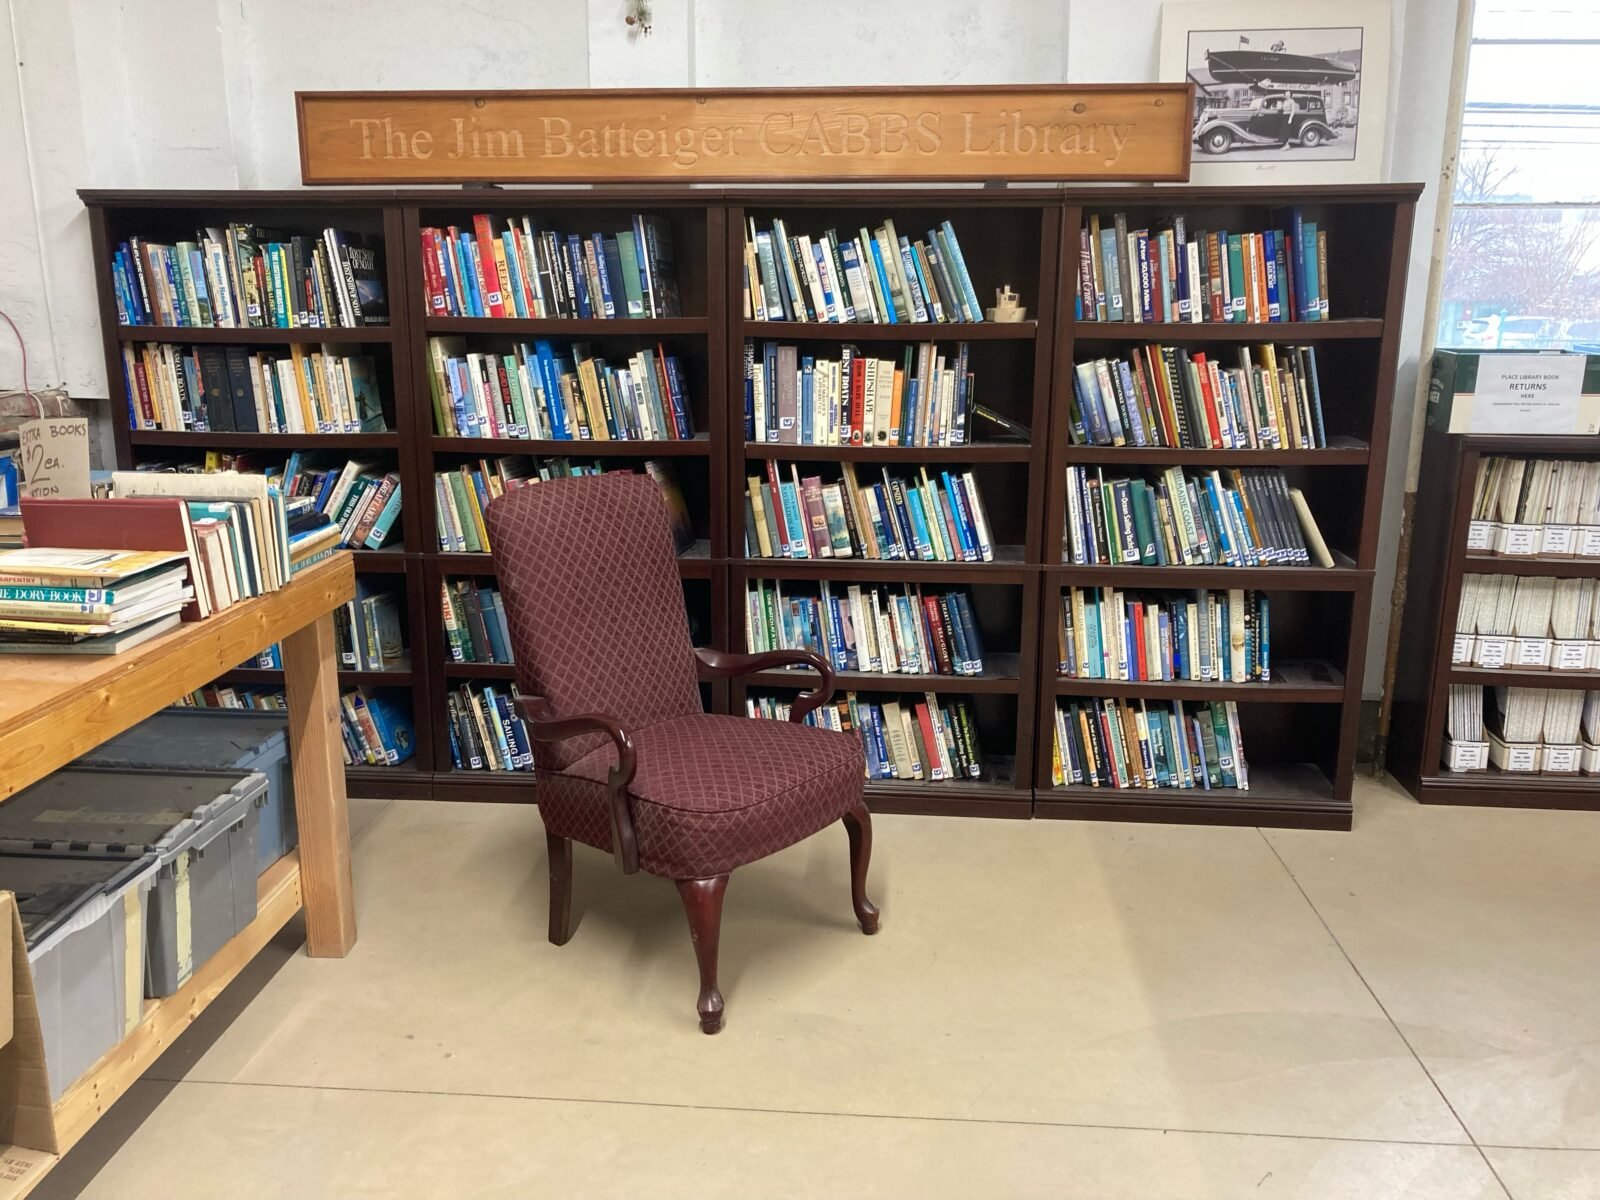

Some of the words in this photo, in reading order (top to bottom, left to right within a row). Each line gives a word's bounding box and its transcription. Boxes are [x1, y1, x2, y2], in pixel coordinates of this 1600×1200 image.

[349, 117, 433, 160] The
[447, 115, 526, 160] Jim
[538, 112, 743, 169] Batteiger
[759, 111, 943, 156] CABBS
[959, 110, 1136, 167] Library
[1078, 249, 1091, 273] Where
[1138, 239, 1147, 260] After
[1209, 234, 1219, 275] RESOLUTE
[1140, 260, 1149, 288] 50,000
[1081, 280, 1094, 307] Cruise
[1142, 288, 1150, 311] Miles
[746, 343, 754, 379] CHAPMAN
[842, 348, 850, 373] BEST
[842, 375, 850, 406] BOATS
[865, 360, 875, 416] SHIPSHAPE
[1509, 383, 1547, 391] RETURNS
[22, 427, 41, 446] EXTRA
[49, 424, 86, 438] BOOKS
[373, 478, 392, 504] GREAT
[361, 499, 380, 525] LAKES
[1120, 496, 1130, 515] Ocean
[1175, 480, 1188, 509] MAINE
[1182, 508, 1195, 537] COAST
[1121, 514, 1133, 535] Sailing
[1125, 533, 1135, 550] Yacht
[15, 589, 46, 601] DORY
[50, 590, 83, 602] BOOK
[437, 582, 452, 621] ON-TIKI
[766, 605, 775, 626] WATCH
[941, 602, 950, 622] HEART
[939, 642, 949, 663] GLORY
[502, 719, 518, 754] SAILING
[951, 714, 961, 738] America's
[955, 738, 965, 755] Sailing
[960, 754, 968, 768] Book
